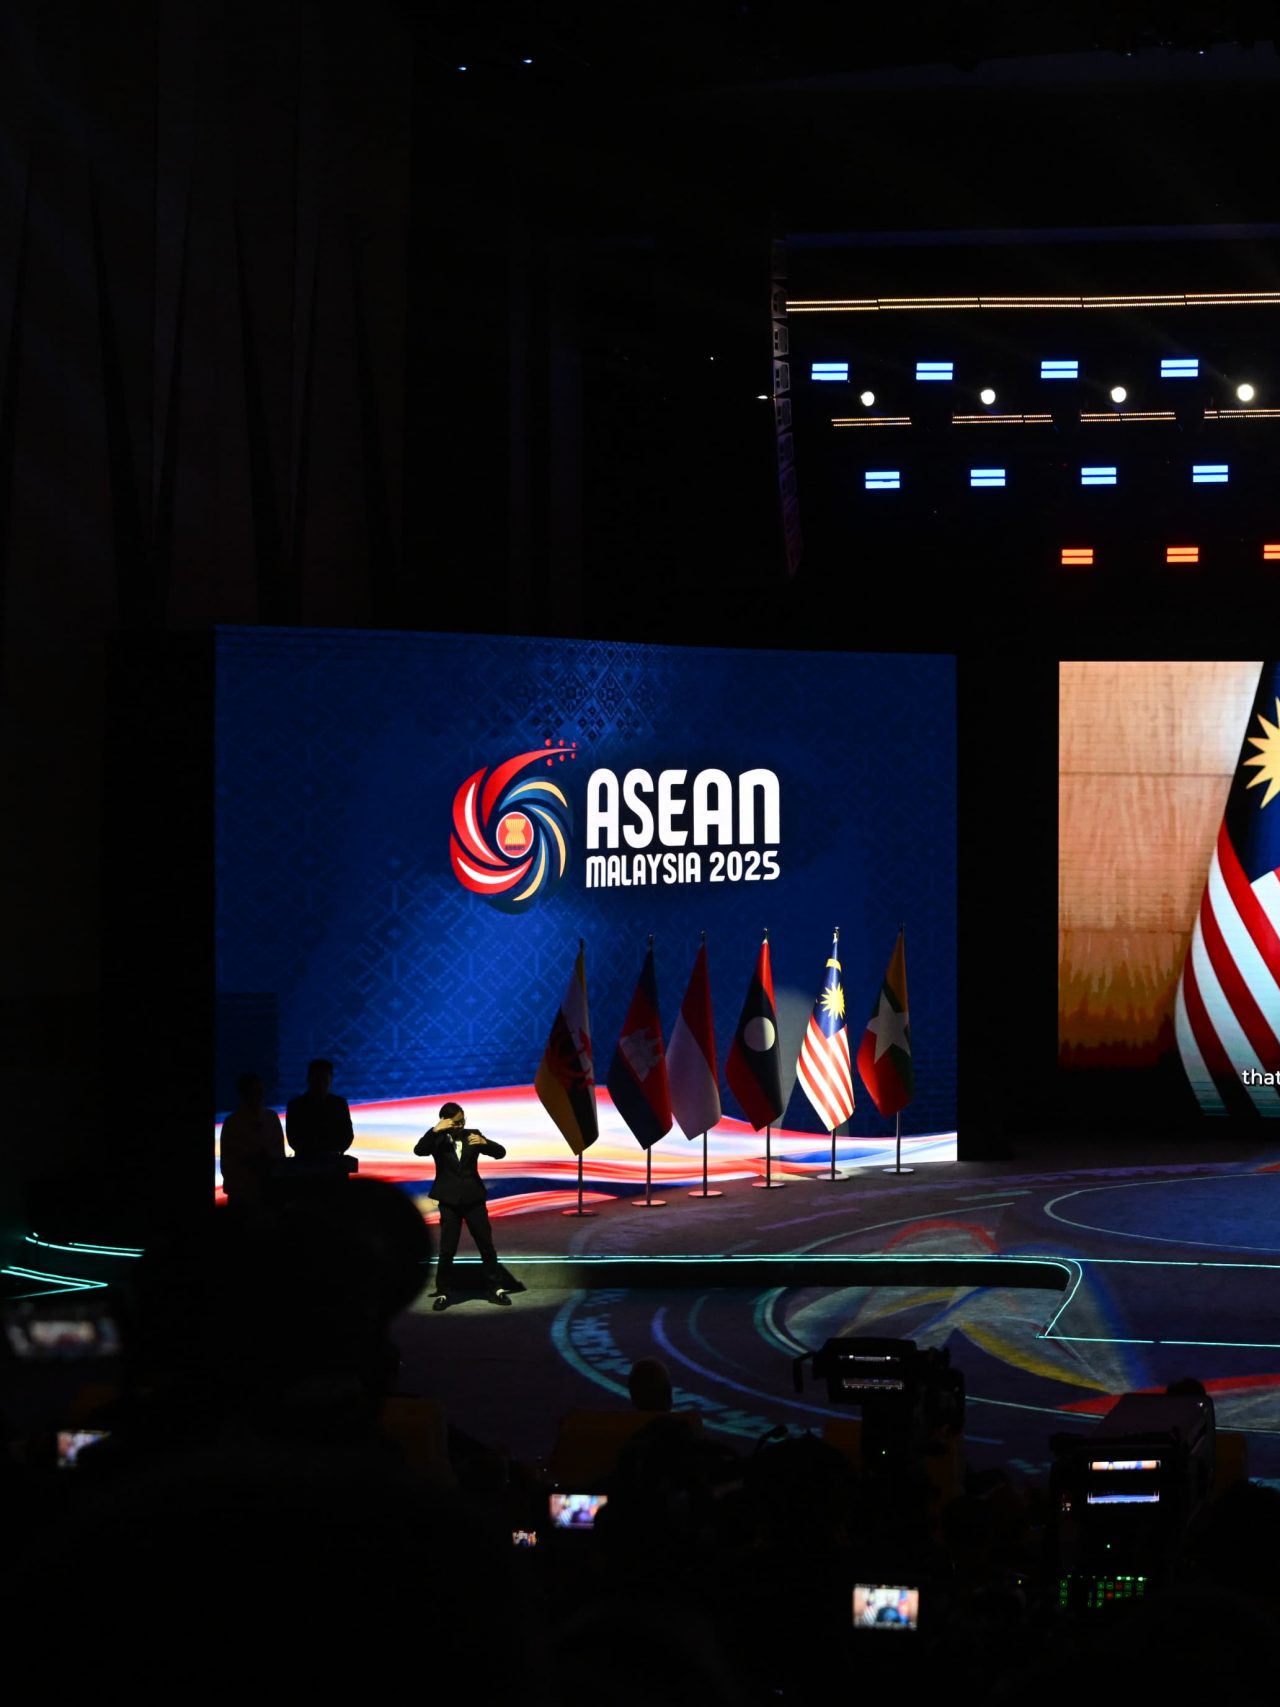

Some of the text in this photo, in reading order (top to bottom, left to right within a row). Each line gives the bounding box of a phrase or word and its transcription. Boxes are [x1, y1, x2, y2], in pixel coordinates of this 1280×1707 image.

[587, 768, 780, 849] ASEAN
[586, 850, 781, 888] MALAYSIA 2025
